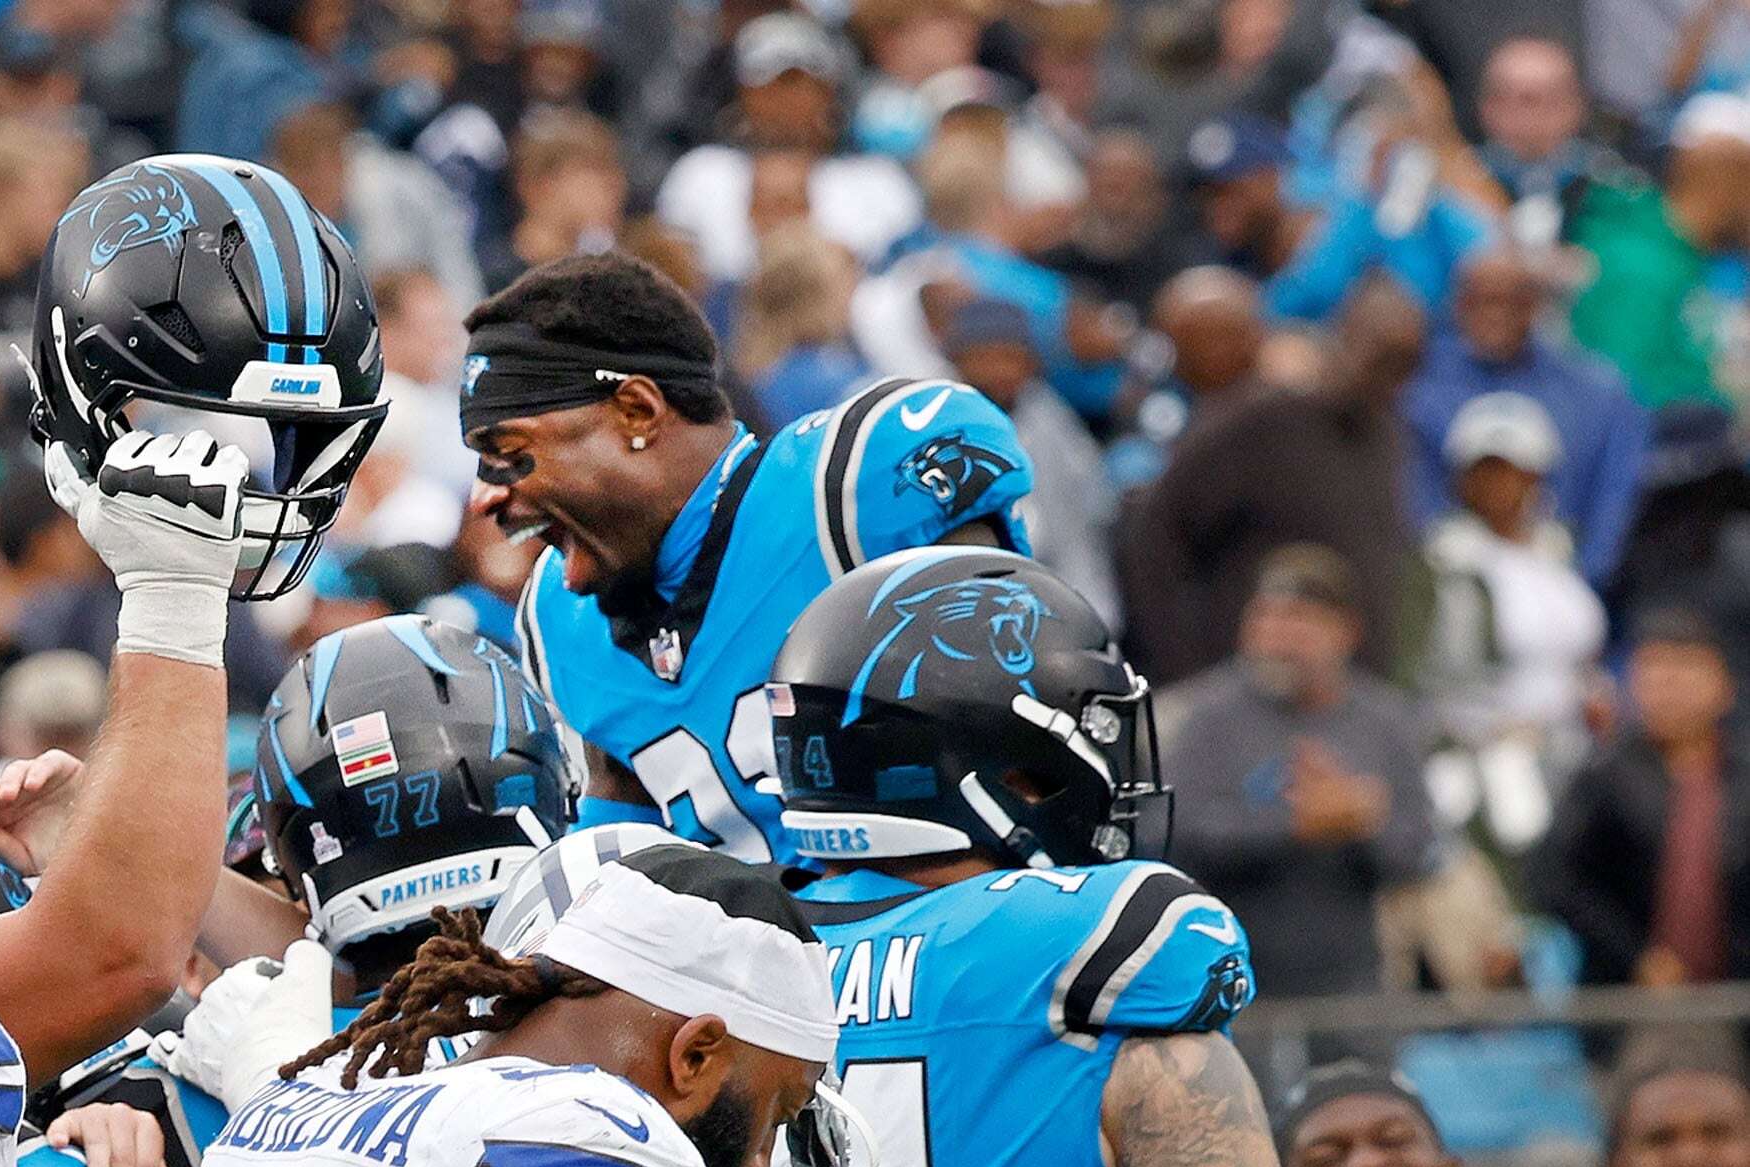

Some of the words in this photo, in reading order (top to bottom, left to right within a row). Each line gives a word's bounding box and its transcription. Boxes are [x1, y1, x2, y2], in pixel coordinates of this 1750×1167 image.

[364, 769, 441, 838] 77
[381, 864, 482, 909] PANTHERS
[827, 934, 925, 1025] AN
